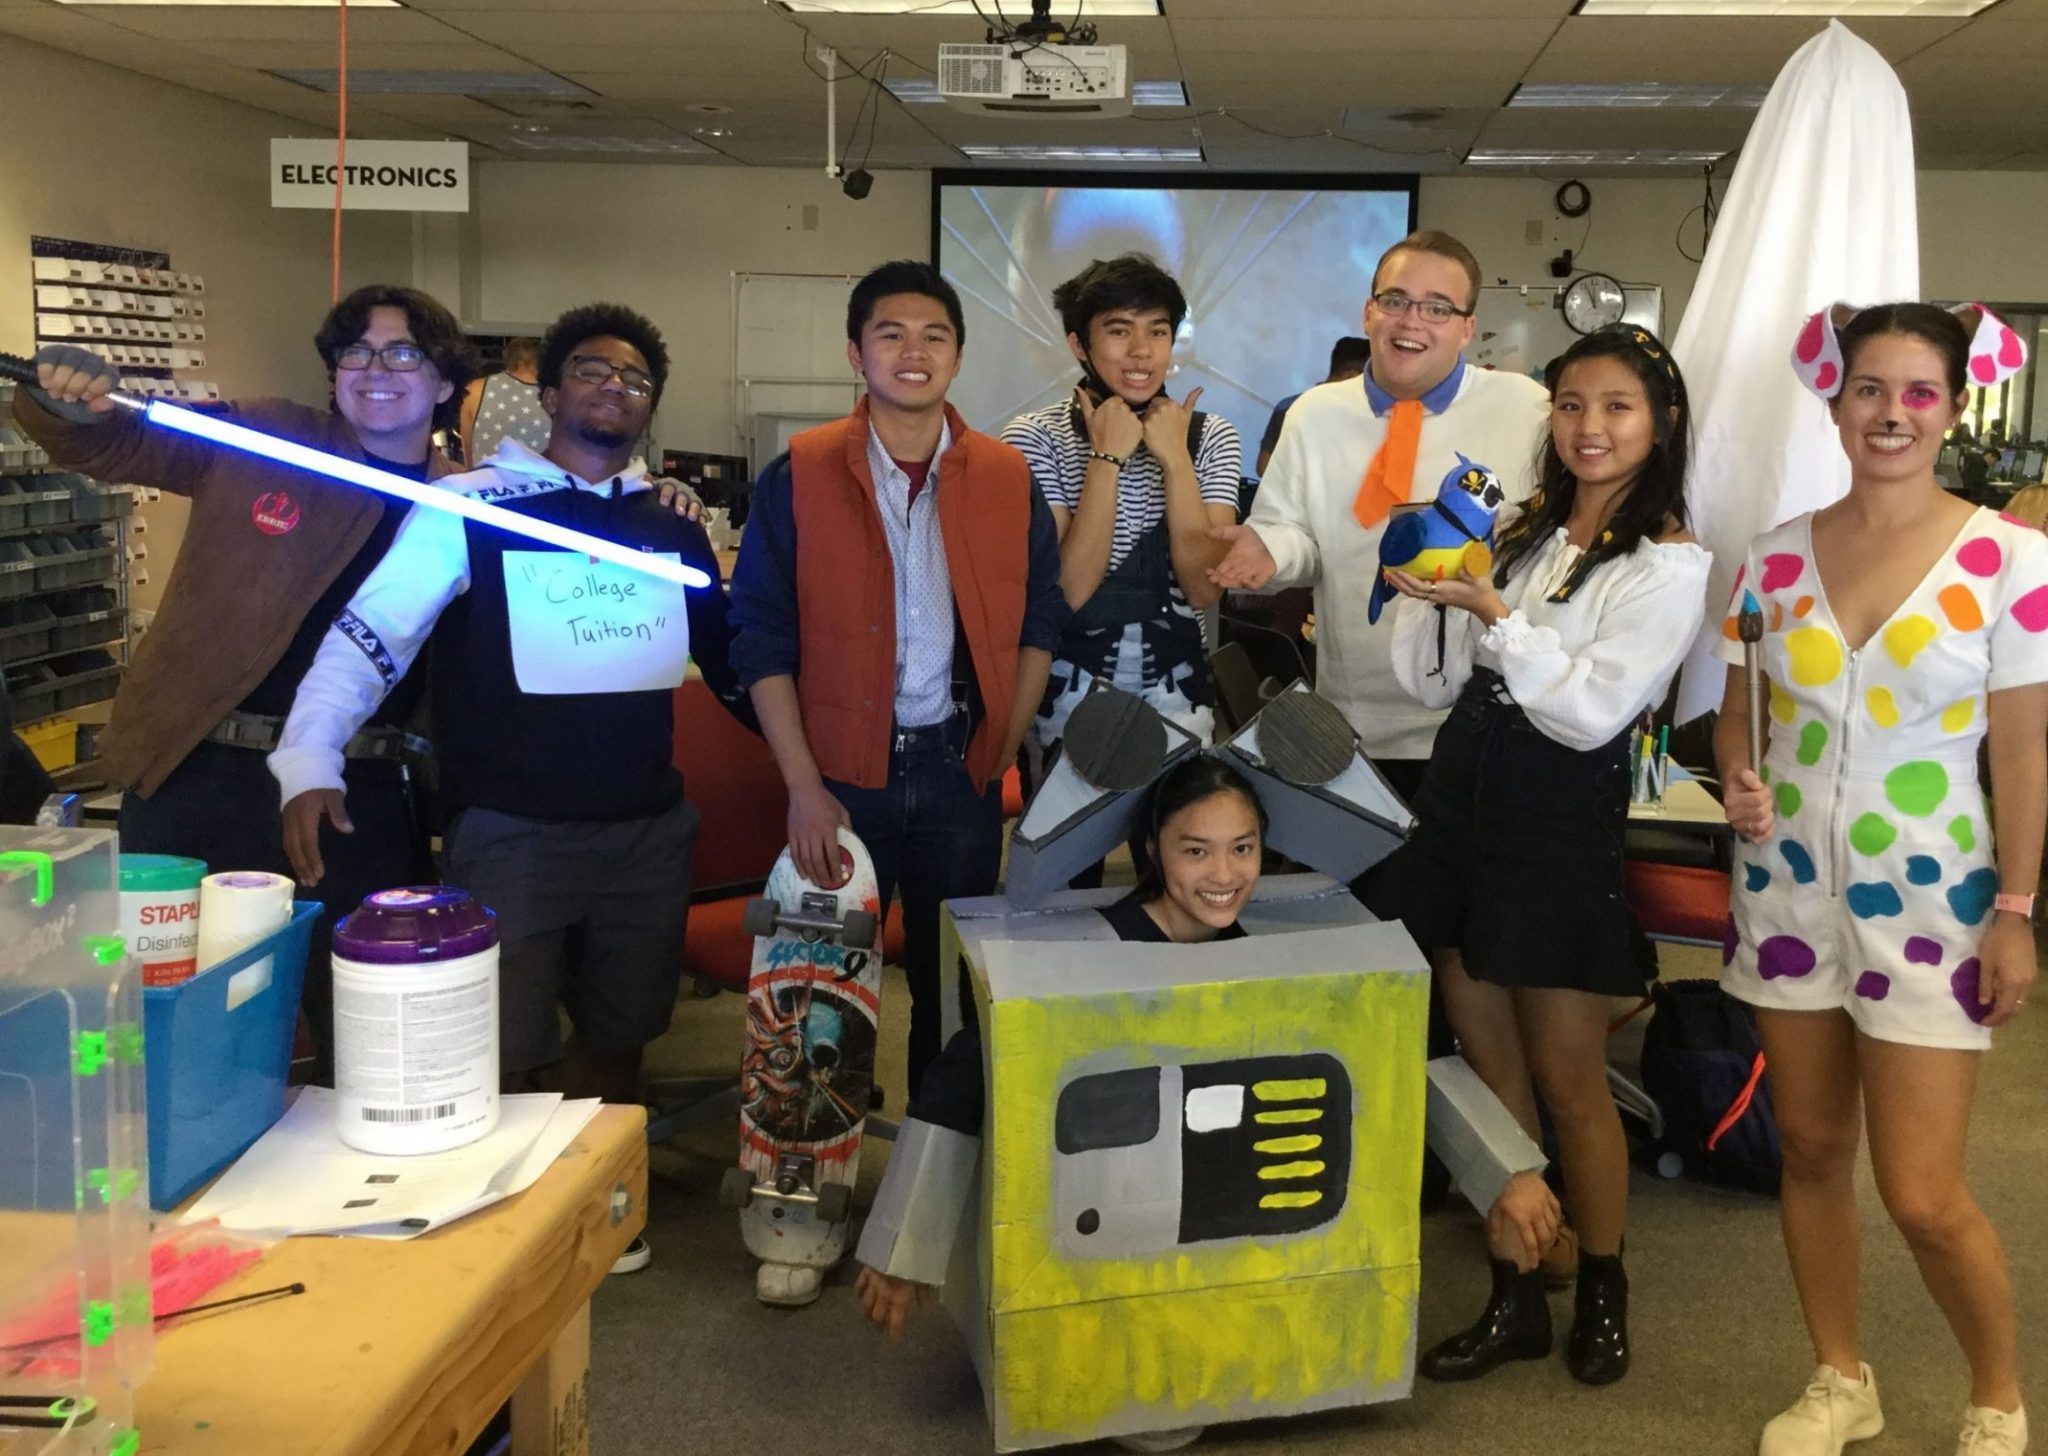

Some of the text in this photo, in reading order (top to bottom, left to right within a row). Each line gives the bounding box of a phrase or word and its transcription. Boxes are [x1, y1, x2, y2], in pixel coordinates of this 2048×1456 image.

[281, 164, 458, 188] ELECTRONICS
[478, 486, 516, 501] FILA
[344, 620, 378, 653] FILA
[567, 616, 666, 646] Tuition"
[140, 902, 200, 926] STAPL
